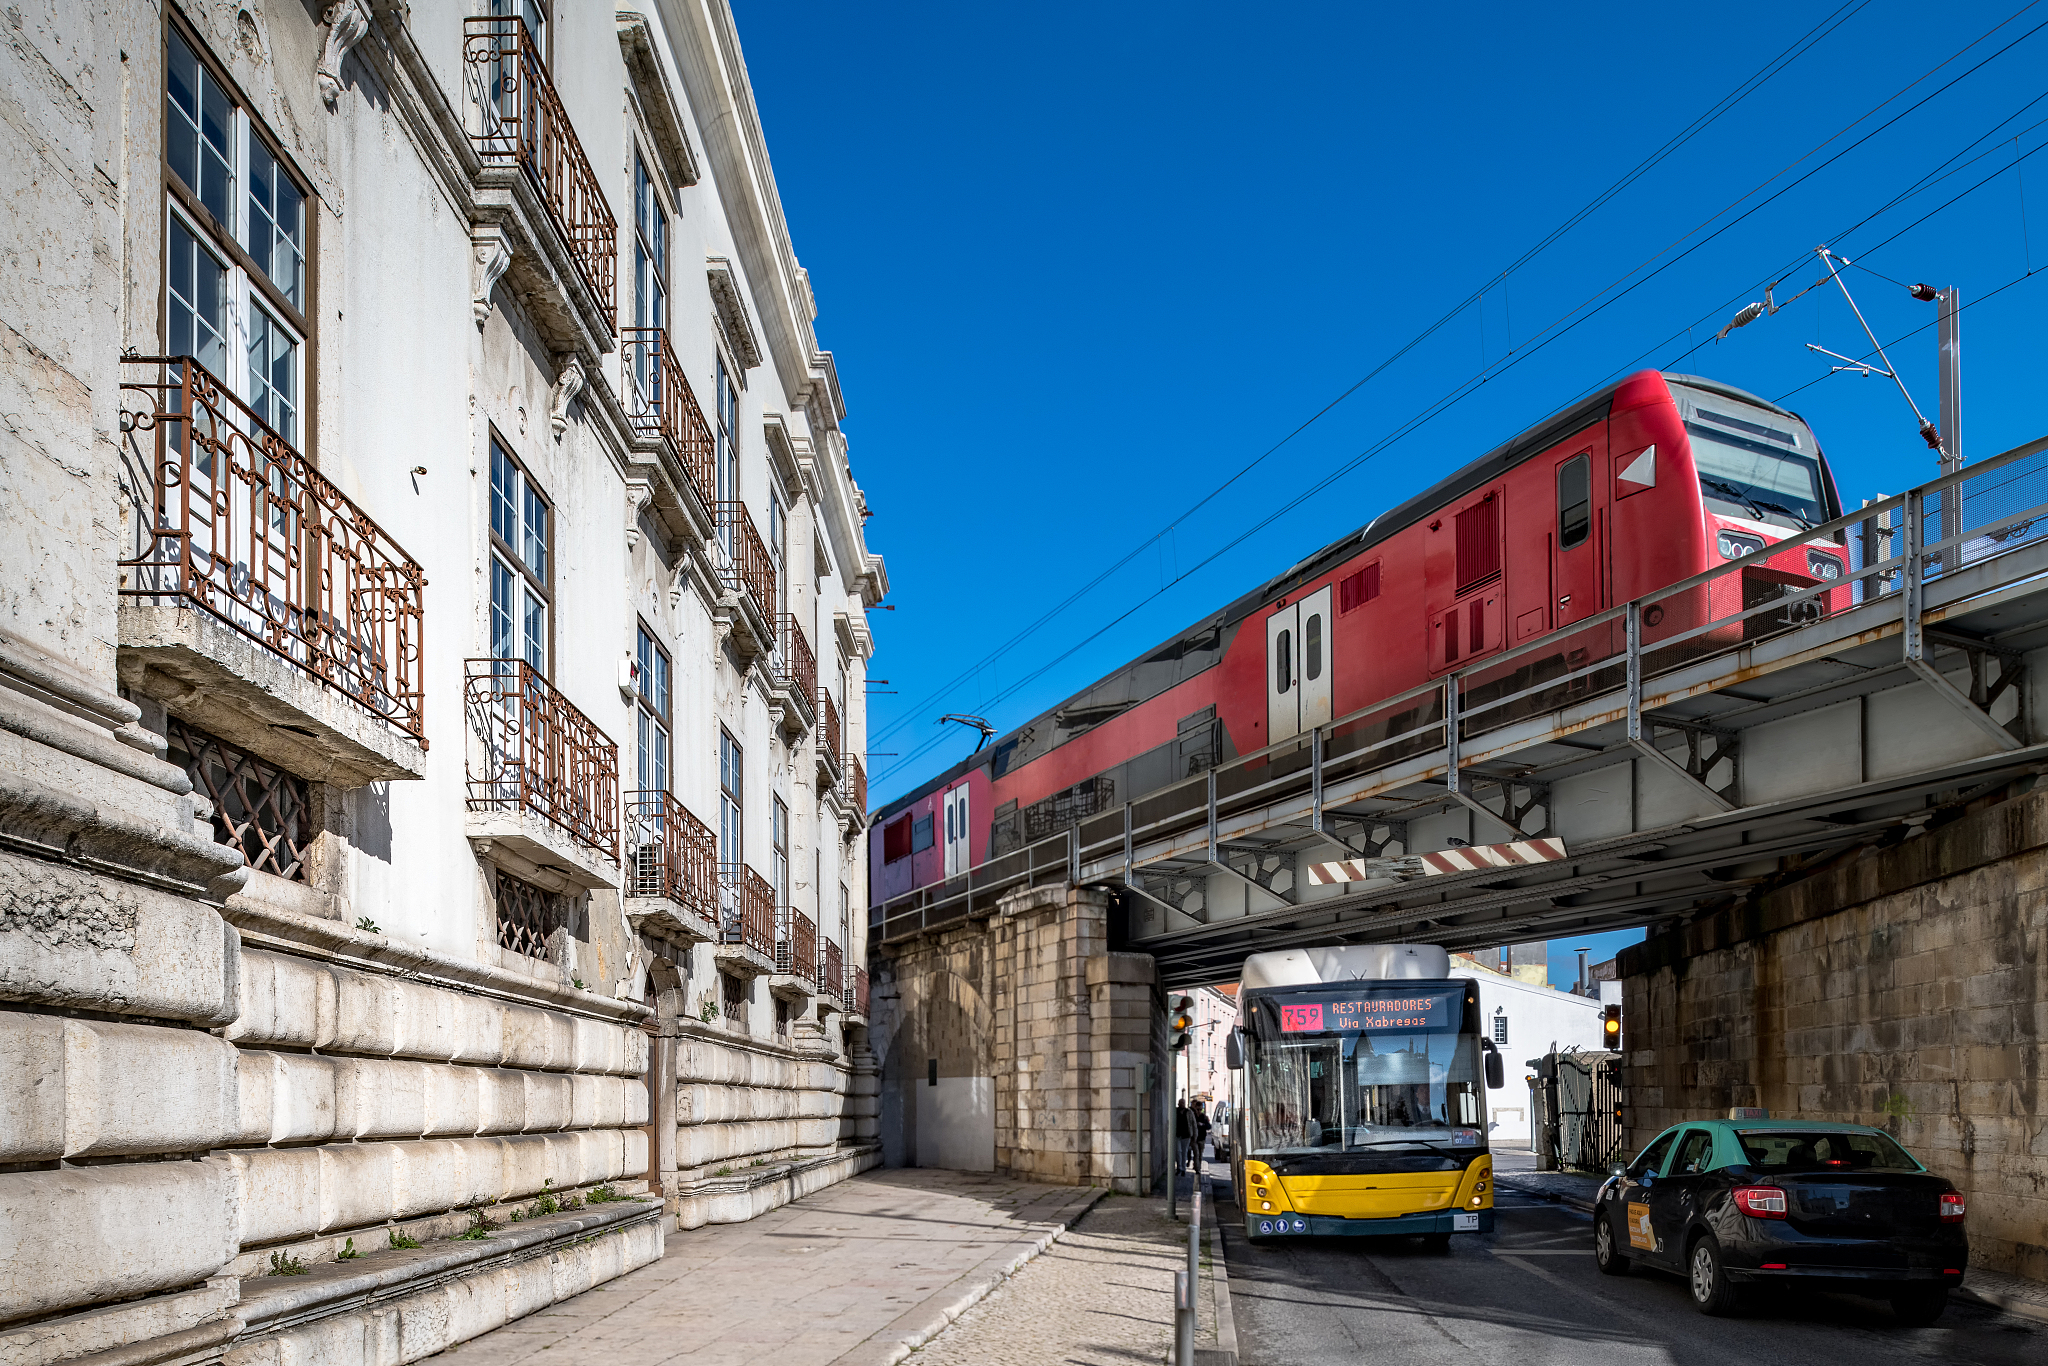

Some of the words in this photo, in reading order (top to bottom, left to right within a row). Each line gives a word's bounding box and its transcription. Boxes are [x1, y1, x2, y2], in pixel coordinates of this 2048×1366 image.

[1332, 999, 1432, 1014] RESTAURADORES
[1284, 1008, 1319, 1026] 759
[1339, 1017, 1359, 1029] Via
[1365, 1016, 1426, 1029] Xabregas
[1745, 1109, 1762, 1117] TAXI
